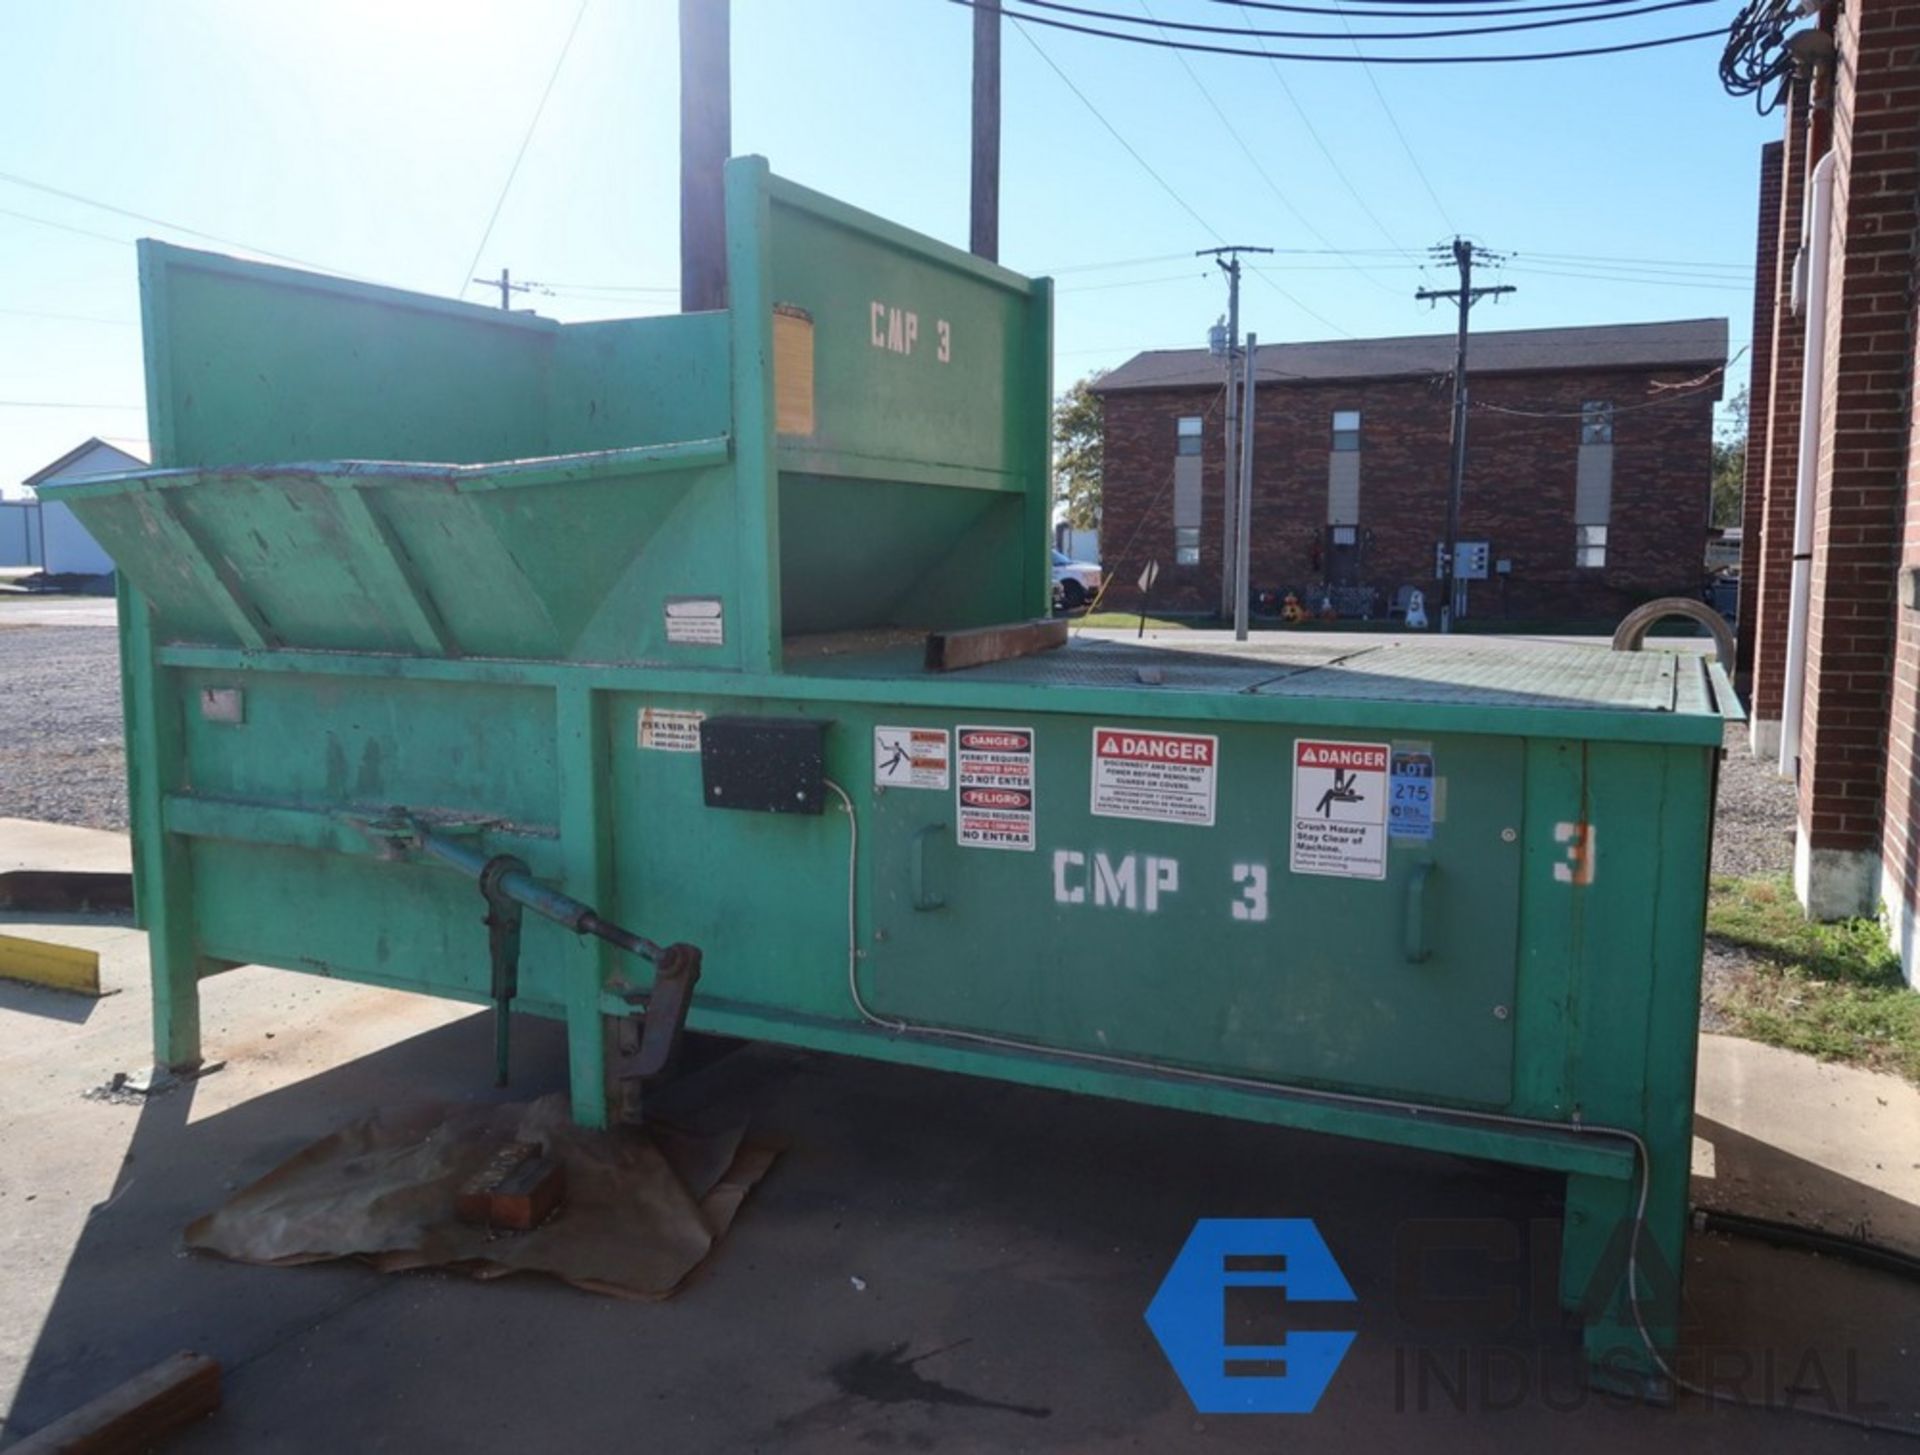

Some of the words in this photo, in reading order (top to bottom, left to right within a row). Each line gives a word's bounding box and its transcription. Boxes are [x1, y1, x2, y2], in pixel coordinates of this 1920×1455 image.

[870, 301, 918, 355] CMP
[937, 319, 950, 363] 3
[969, 736, 1019, 746] DANGER
[1122, 738, 1209, 761] DANGER
[960, 753, 989, 761] PERMIT
[990, 754, 1030, 763] REQUIRED
[1318, 749, 1385, 767] DANGER
[1103, 760, 1149, 769] DISCONNECT
[1168, 764, 1187, 773] LOCK
[1396, 763, 1427, 776] LOT
[960, 774, 973, 783] DO
[976, 775, 996, 784] NOT
[998, 776, 1030, 786] ENTER
[1105, 768, 1131, 776] POWER
[1133, 770, 1161, 779] BEFORE
[1163, 773, 1201, 783] REMOVING
[1116, 778, 1145, 786] GUARDS
[1395, 783, 1429, 801] 275
[969, 793, 1021, 805] PELIGRO
[1296, 821, 1327, 831] Crush
[1329, 824, 1366, 835] Hazard
[963, 831, 980, 840] NO
[982, 832, 1030, 843] ENTRAR
[1296, 833, 1319, 843] Stay
[1321, 834, 1350, 844] Clear
[1352, 837, 1363, 845] of
[1296, 843, 1342, 853] Machine.
[1553, 821, 1596, 886] 3
[1053, 850, 1179, 912] CMP
[1232, 864, 1269, 921] 3
